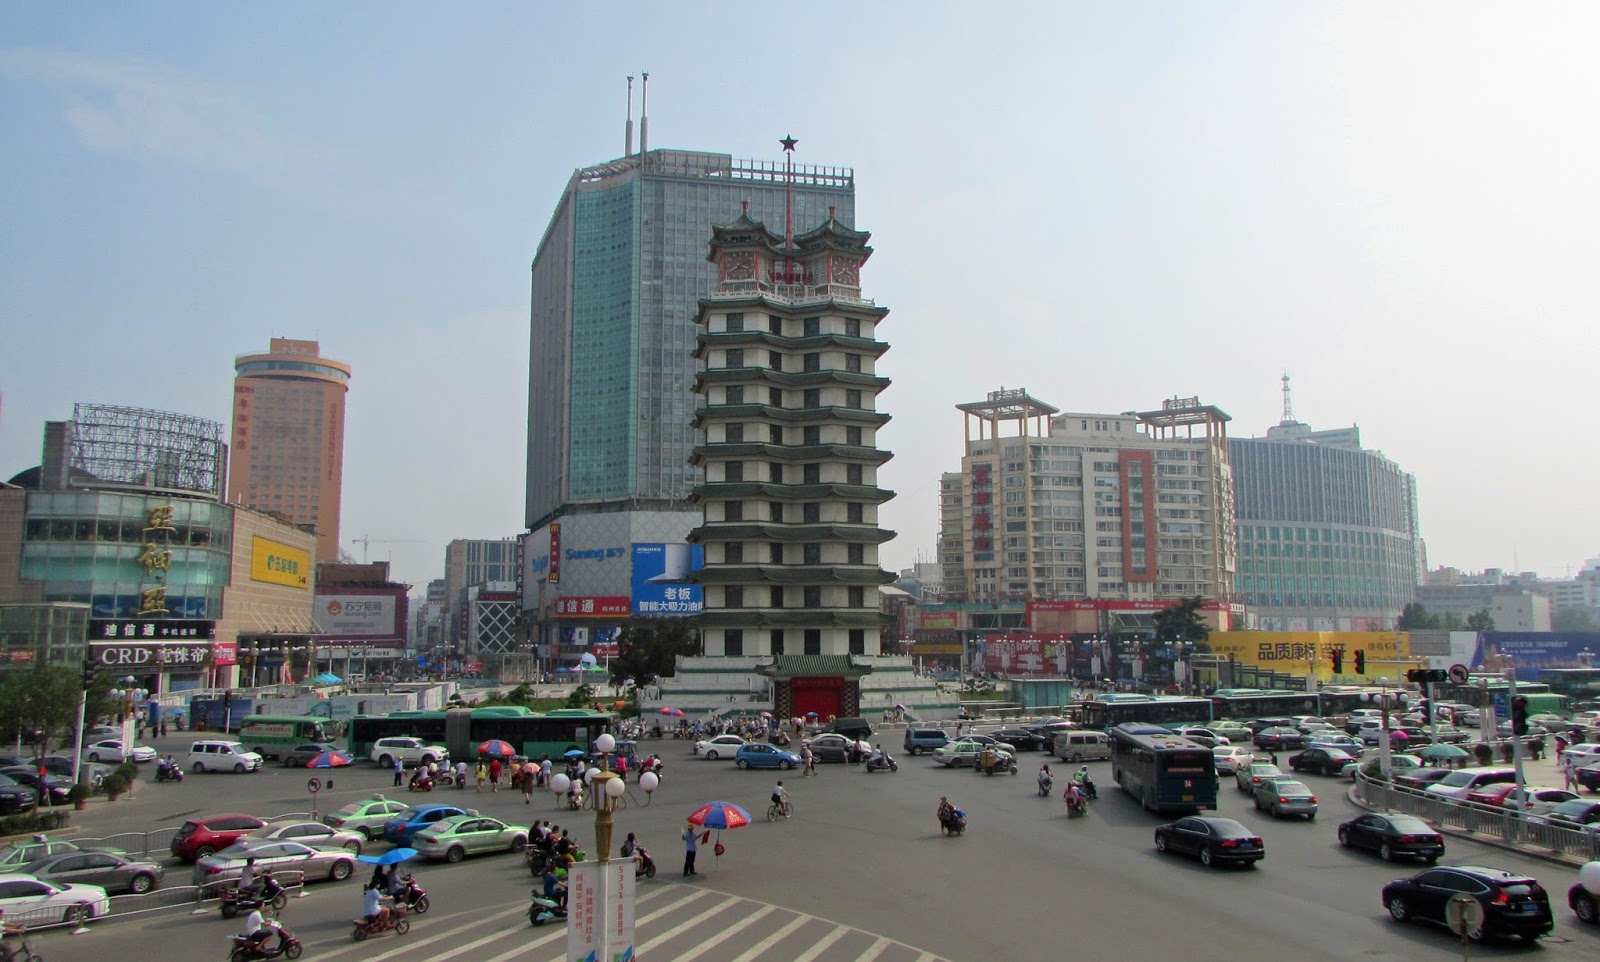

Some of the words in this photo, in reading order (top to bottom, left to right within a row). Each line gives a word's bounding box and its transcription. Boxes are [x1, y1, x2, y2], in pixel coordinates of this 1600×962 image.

[565, 548, 604, 562] Suning
[665, 588, 691, 600] 老板
[345, 602, 382, 612] 苏宁易购
[104, 624, 155, 636] 迪信通
[102, 648, 149, 664] CRD
[1258, 642, 1317, 661] 品质康桥
